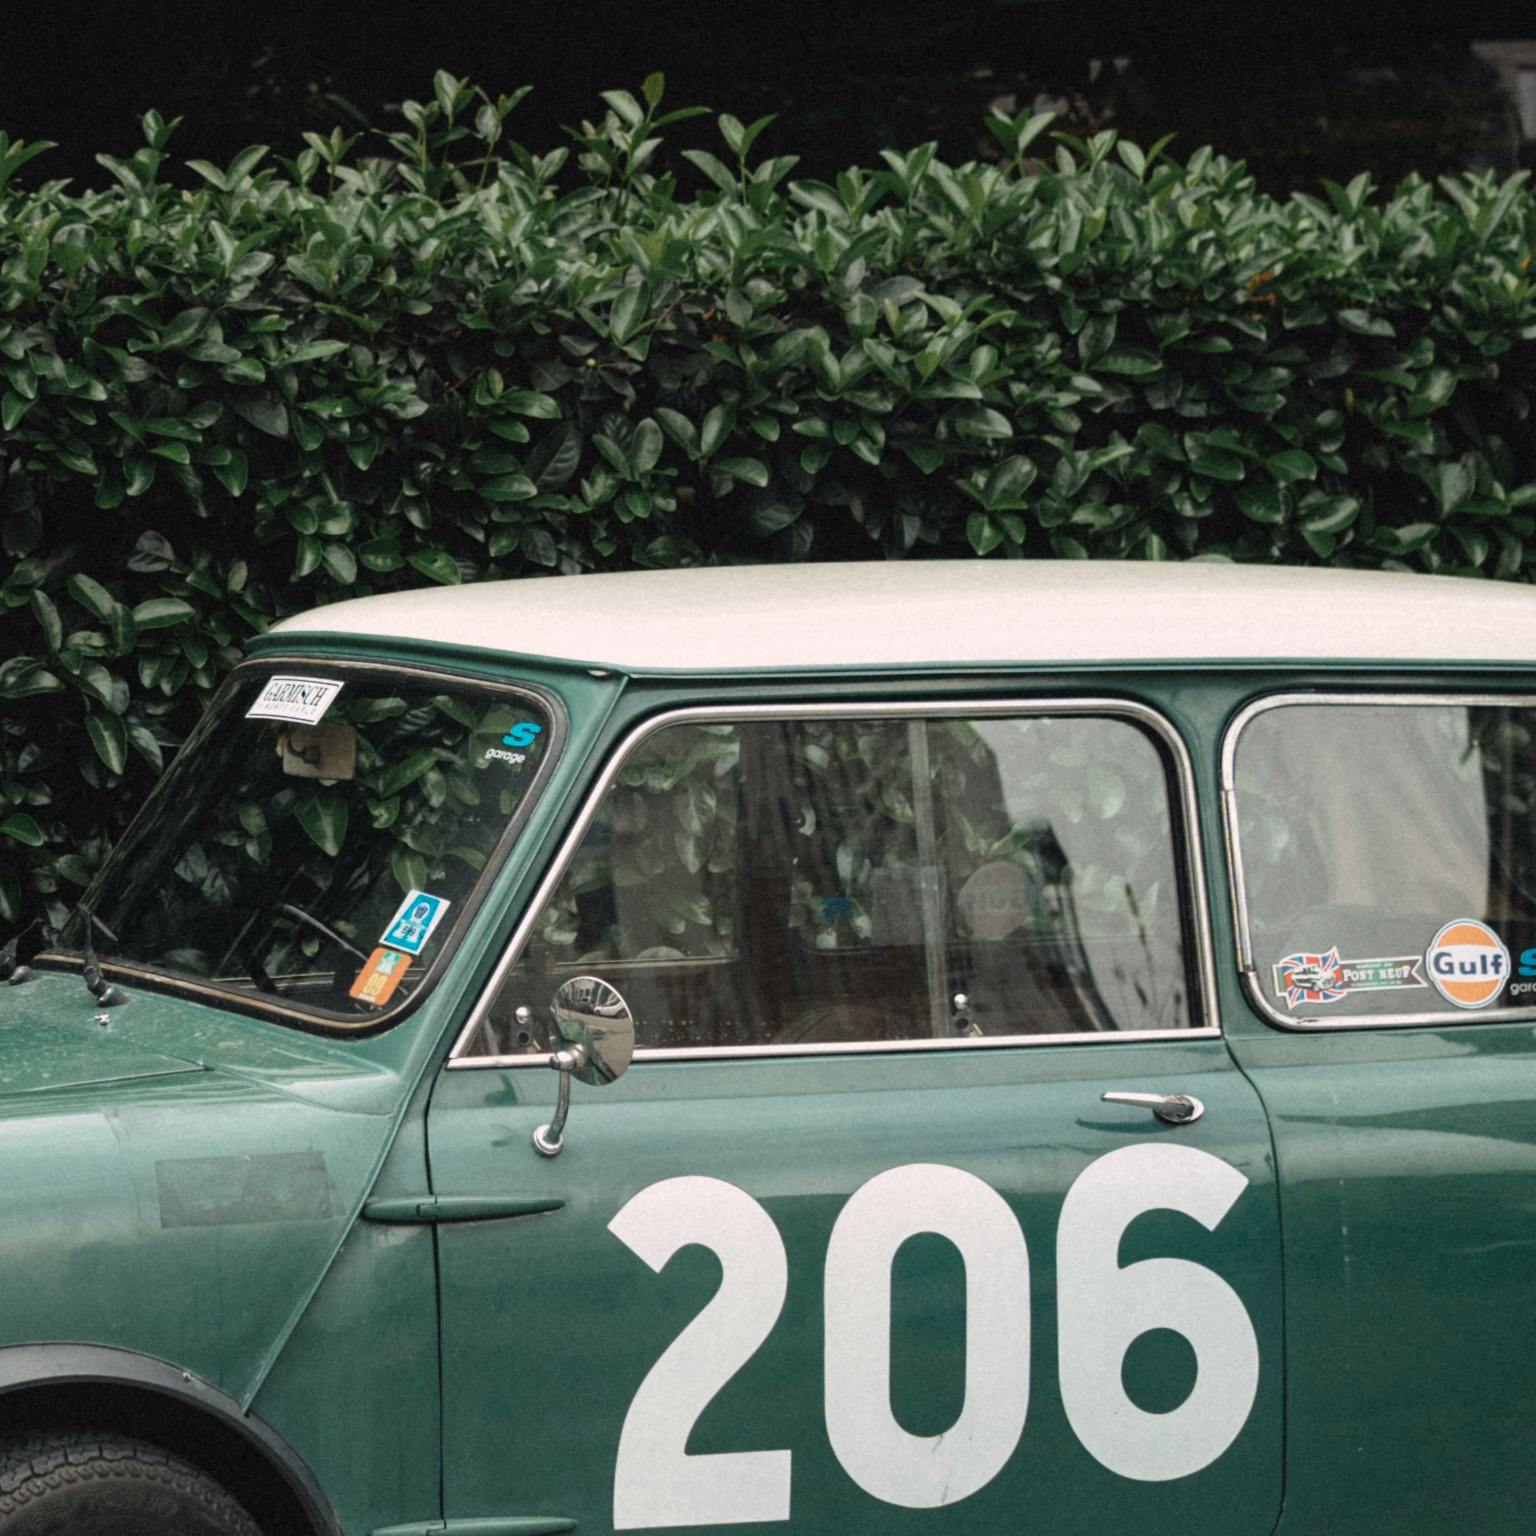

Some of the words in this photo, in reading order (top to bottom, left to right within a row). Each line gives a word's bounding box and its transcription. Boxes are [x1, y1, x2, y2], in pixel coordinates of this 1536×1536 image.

[502, 722, 542, 747] S
[484, 748, 526, 765] garage
[1433, 952, 1503, 975] Gulf
[606, 1141, 1260, 1531] 206
